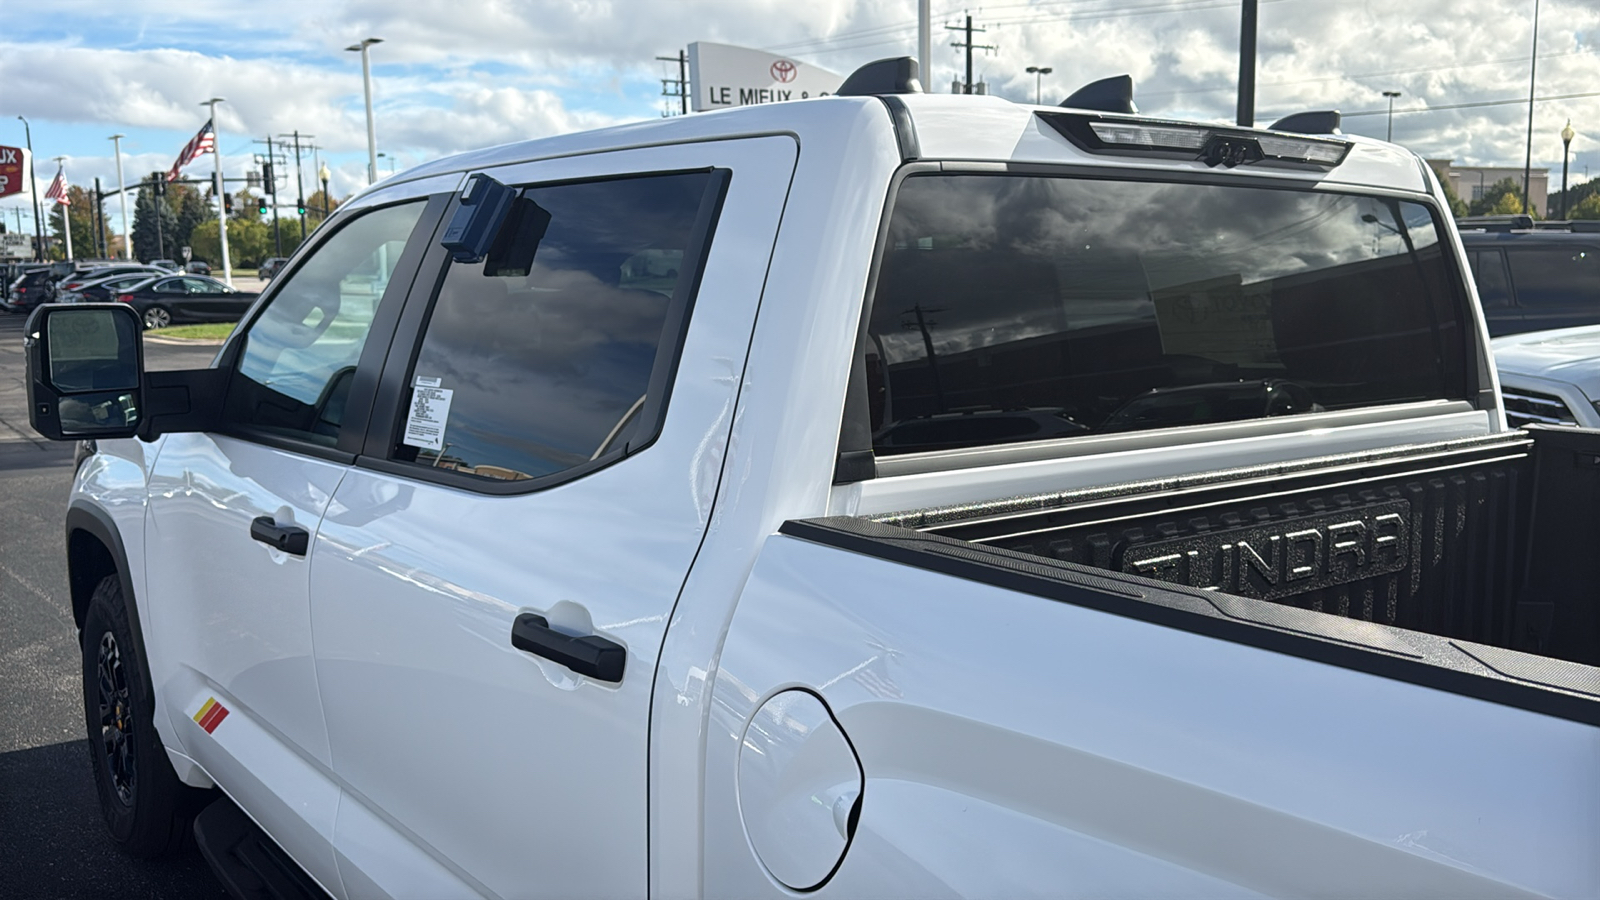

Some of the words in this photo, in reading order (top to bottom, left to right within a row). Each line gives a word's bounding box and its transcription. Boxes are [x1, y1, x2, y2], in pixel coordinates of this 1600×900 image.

[710, 86, 732, 105] LE
[739, 88, 792, 105] MIEUX
[1132, 512, 1405, 591] TUNDRA
